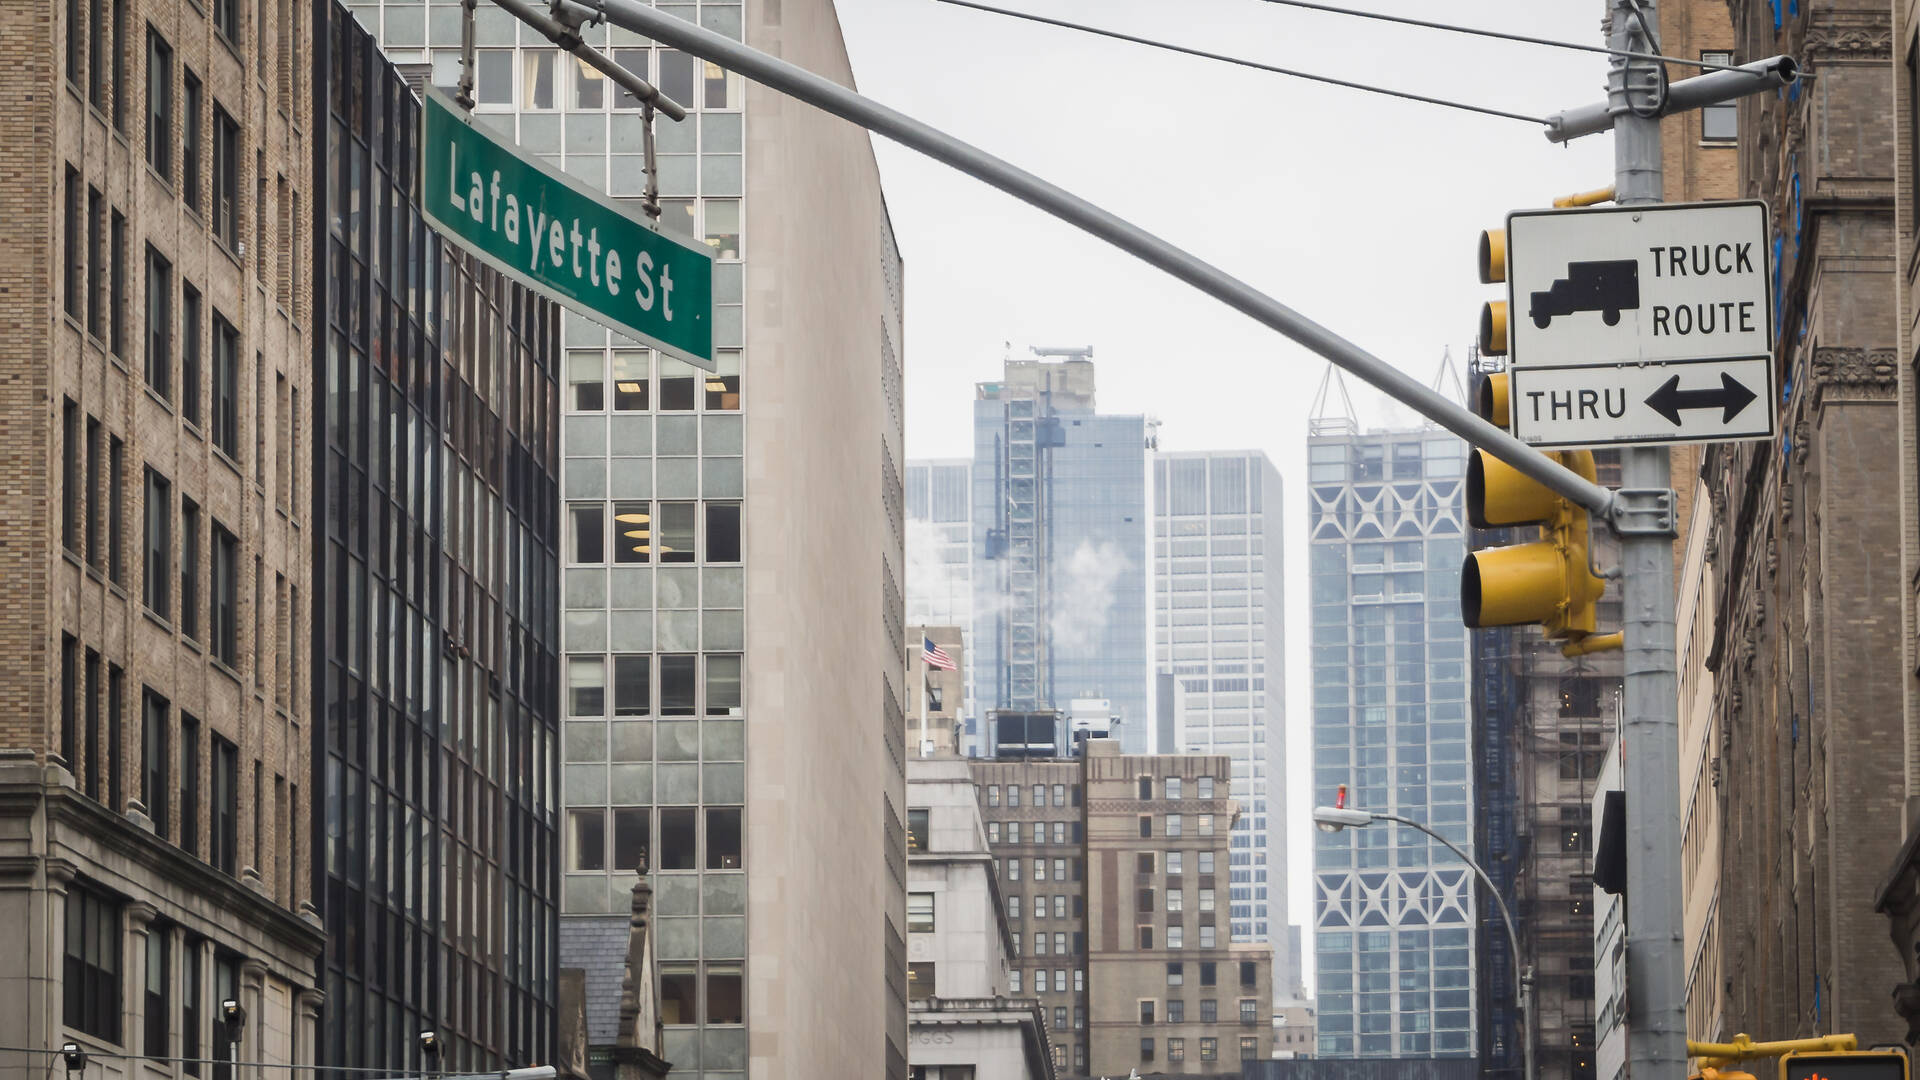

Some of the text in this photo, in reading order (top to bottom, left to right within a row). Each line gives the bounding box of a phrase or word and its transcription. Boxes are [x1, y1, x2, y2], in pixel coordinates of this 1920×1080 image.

[450, 141, 674, 322] Lafayette St
[1650, 242, 1754, 277] TRUCK
[1652, 301, 1756, 336] ROUTE
[1526, 388, 1626, 421] THRU
